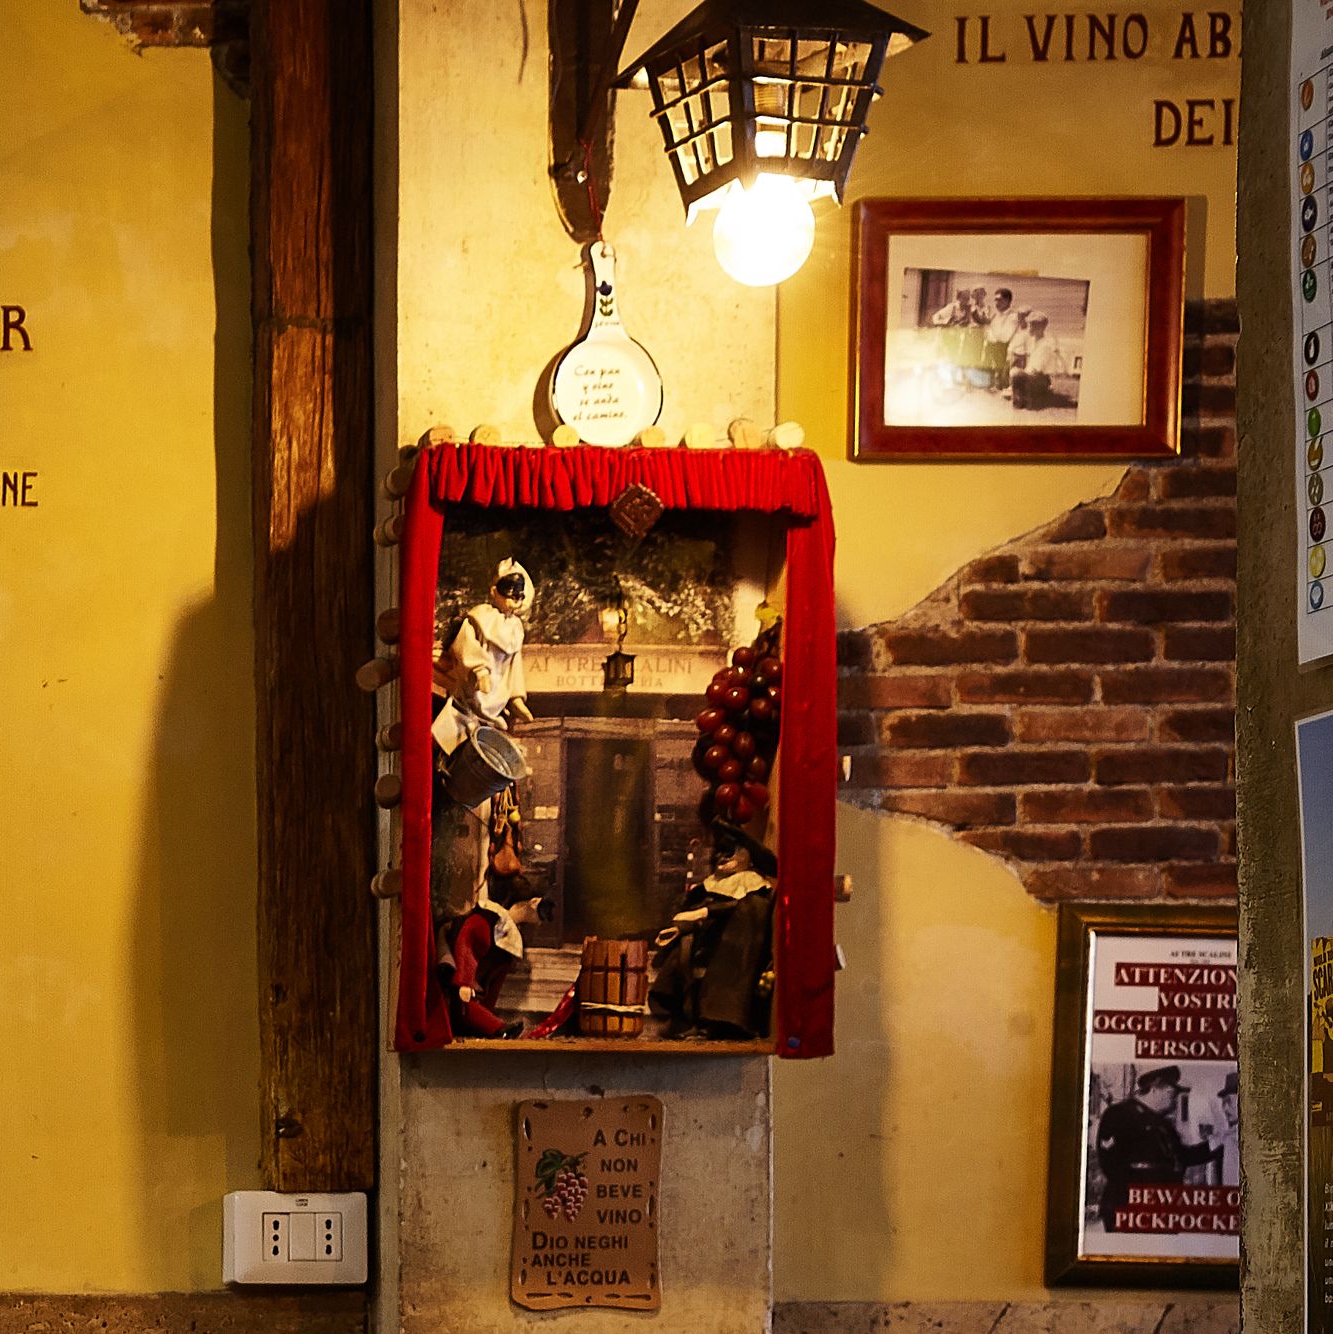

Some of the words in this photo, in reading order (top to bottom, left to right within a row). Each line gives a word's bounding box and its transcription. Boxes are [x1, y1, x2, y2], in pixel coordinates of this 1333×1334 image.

[955, 15, 1006, 64] IL
[1024, 12, 1149, 62] VINO
[1171, 11, 1242, 59] AB
[1094, 1015, 1191, 1033] OGGETTI
[1200, 1017, 1213, 1033] E
[1219, 1017, 1237, 1033] V
[1136, 1040, 1235, 1057] PERSONA
[593, 1129, 607, 1147] A
[600, 1158, 638, 1173] NON
[596, 1184, 643, 1199] BEVE
[1127, 1188, 1219, 1206] BEWARE
[596, 1209, 642, 1225] VINO
[1115, 1211, 1239, 1231] PICKPOCKE
[575, 1235, 629, 1249] NEGHI
[531, 1253, 591, 1268] ANCHE
[546, 1270, 631, 1286] L'ACQUA
